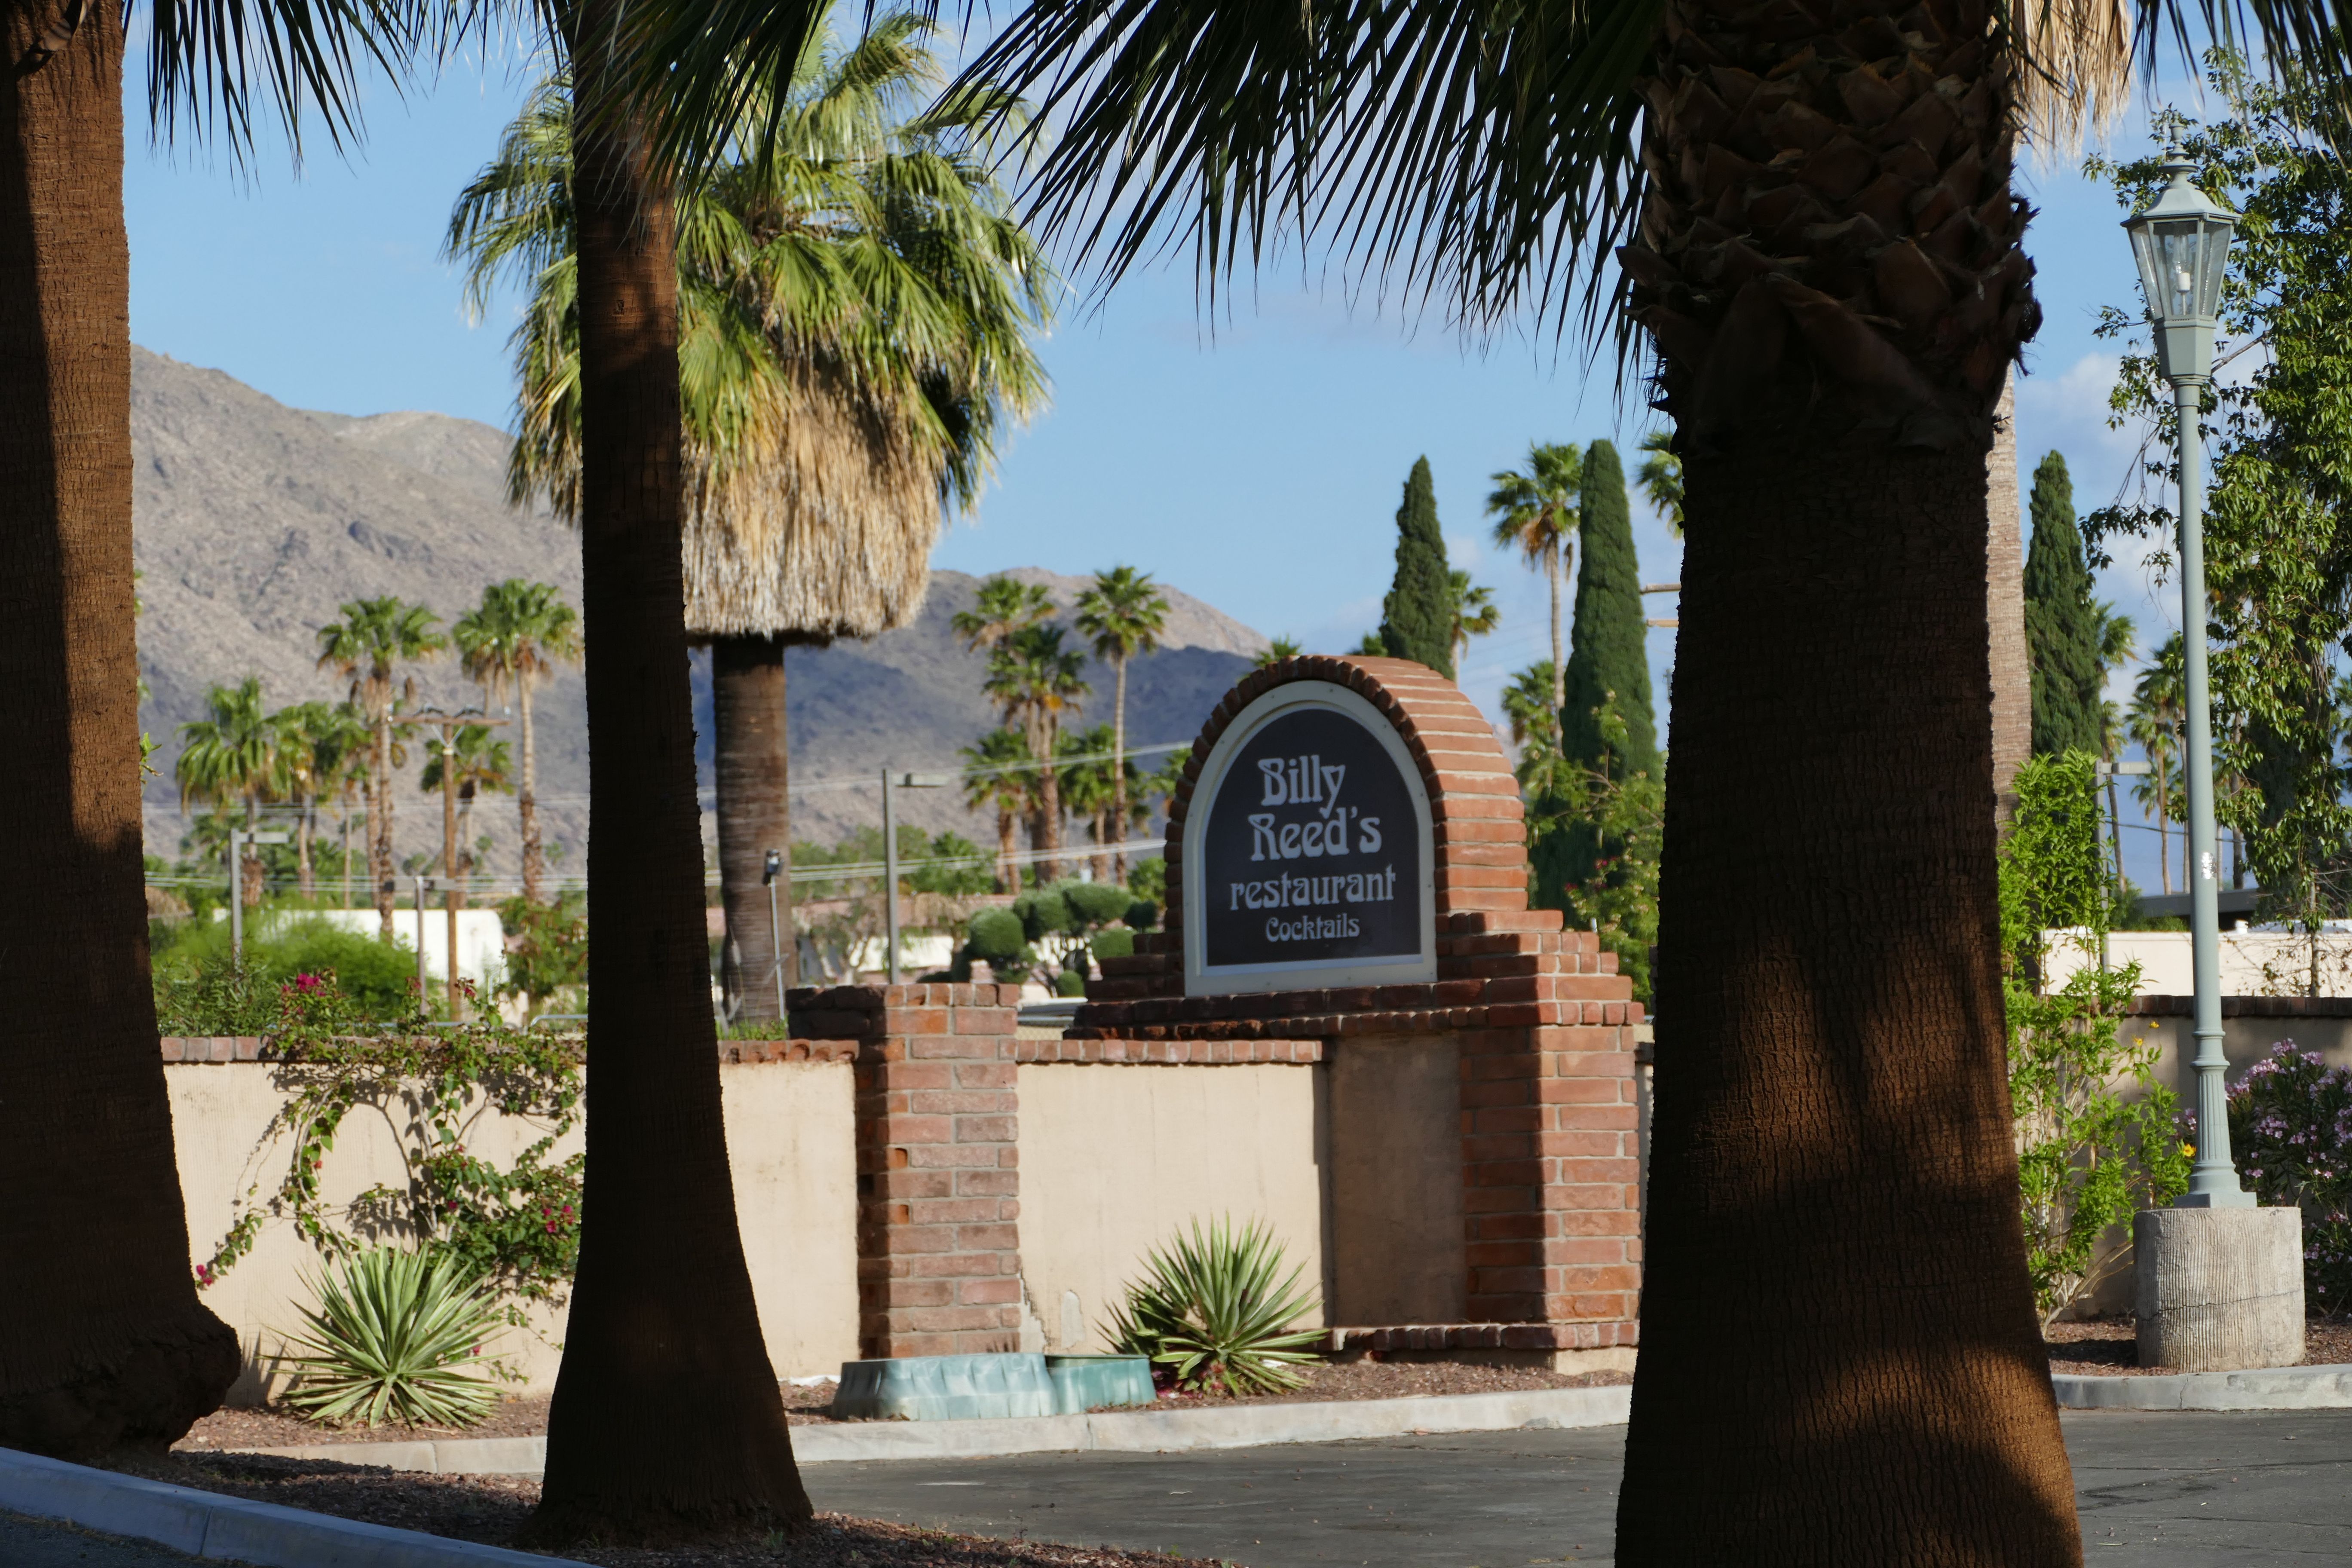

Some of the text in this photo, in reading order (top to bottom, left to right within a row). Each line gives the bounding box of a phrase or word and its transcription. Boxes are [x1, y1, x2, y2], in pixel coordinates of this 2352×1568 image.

[1258, 754, 1346, 819] Billy
[1248, 806, 1382, 861] Reed's
[1230, 864, 1396, 910] restaurant
[1265, 913, 1360, 942] Cocktails
